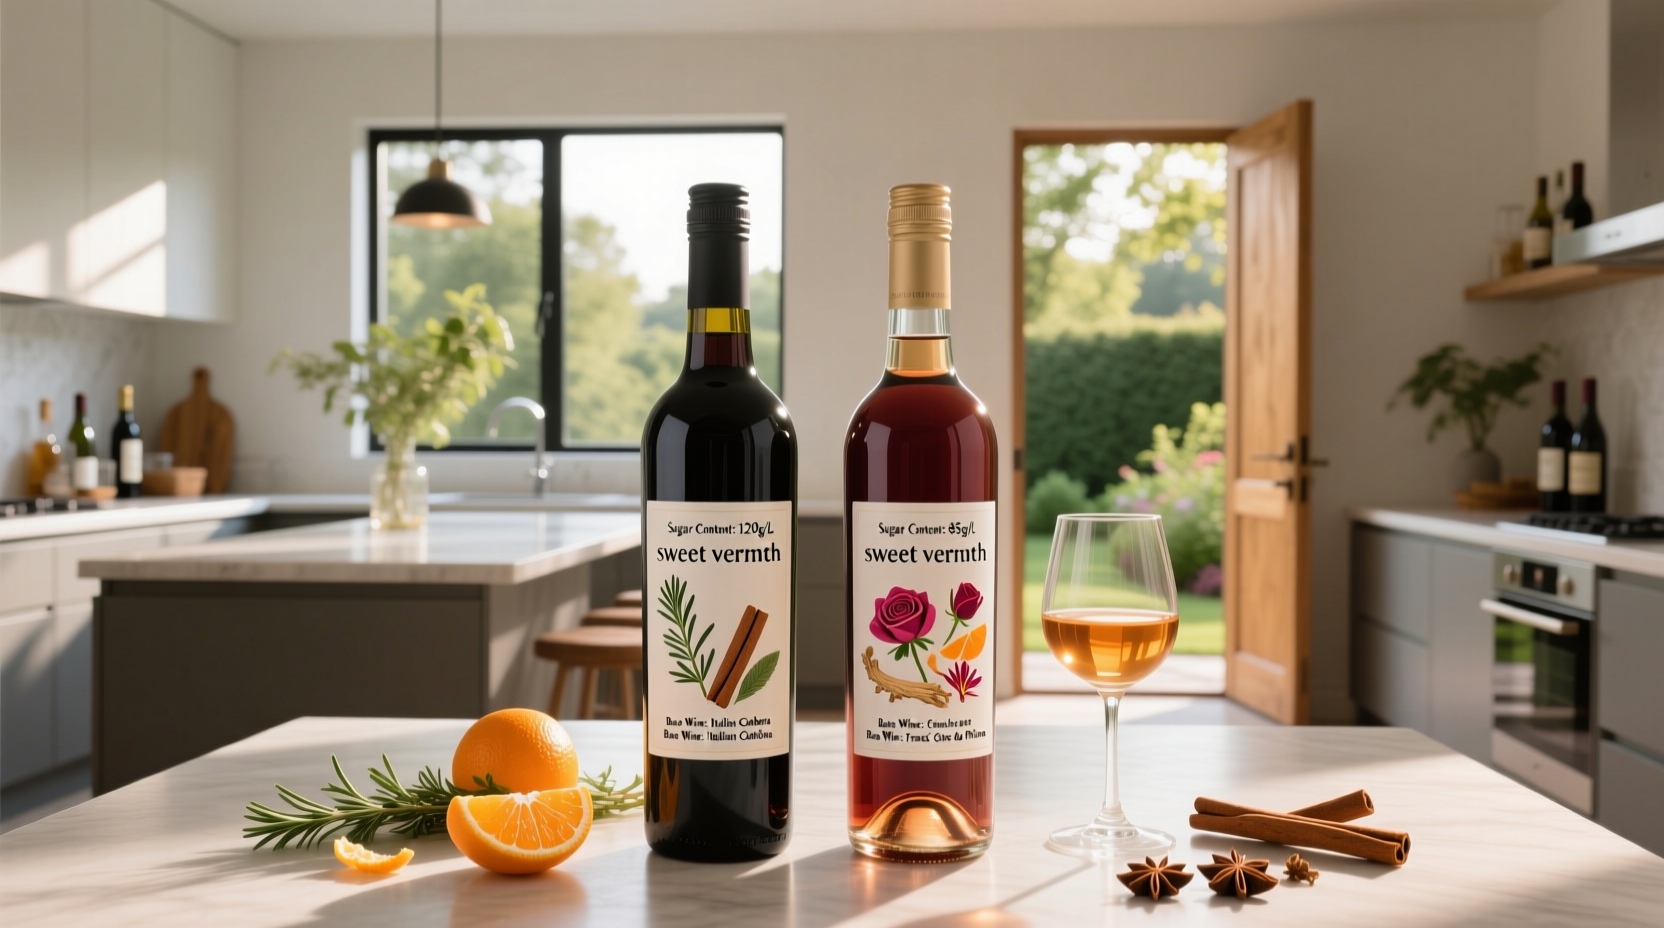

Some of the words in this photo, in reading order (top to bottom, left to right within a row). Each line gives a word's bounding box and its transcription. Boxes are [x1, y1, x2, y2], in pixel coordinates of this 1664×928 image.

[738, 521, 774, 538] 120g/L
[878, 521, 905, 537] Sugar
[657, 545, 706, 563] sweet
[864, 545, 918, 563] sweet
